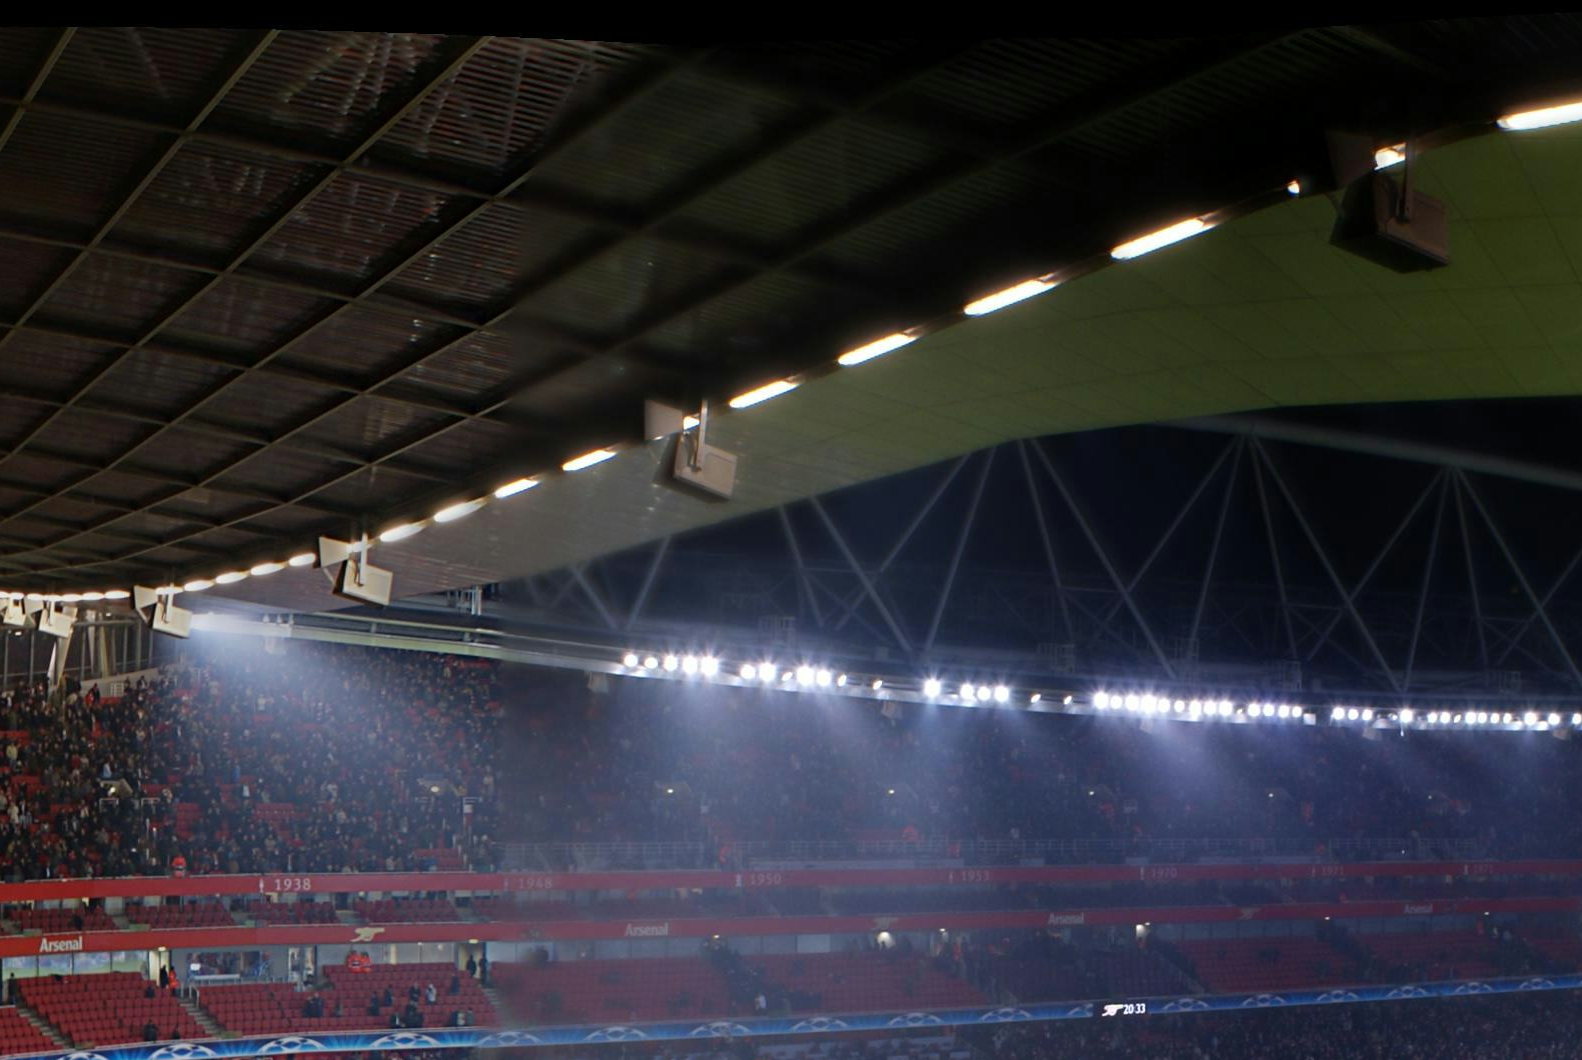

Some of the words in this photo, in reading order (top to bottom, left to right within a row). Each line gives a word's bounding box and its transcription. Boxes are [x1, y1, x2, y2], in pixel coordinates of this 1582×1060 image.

[274, 877, 312, 892] 1938
[519, 877, 553, 890] 1948
[750, 873, 782, 886] 1950
[1047, 912, 1086, 926] Arsenal
[624, 921, 669, 937] Arsenal
[39, 935, 83, 953] Arsenal
